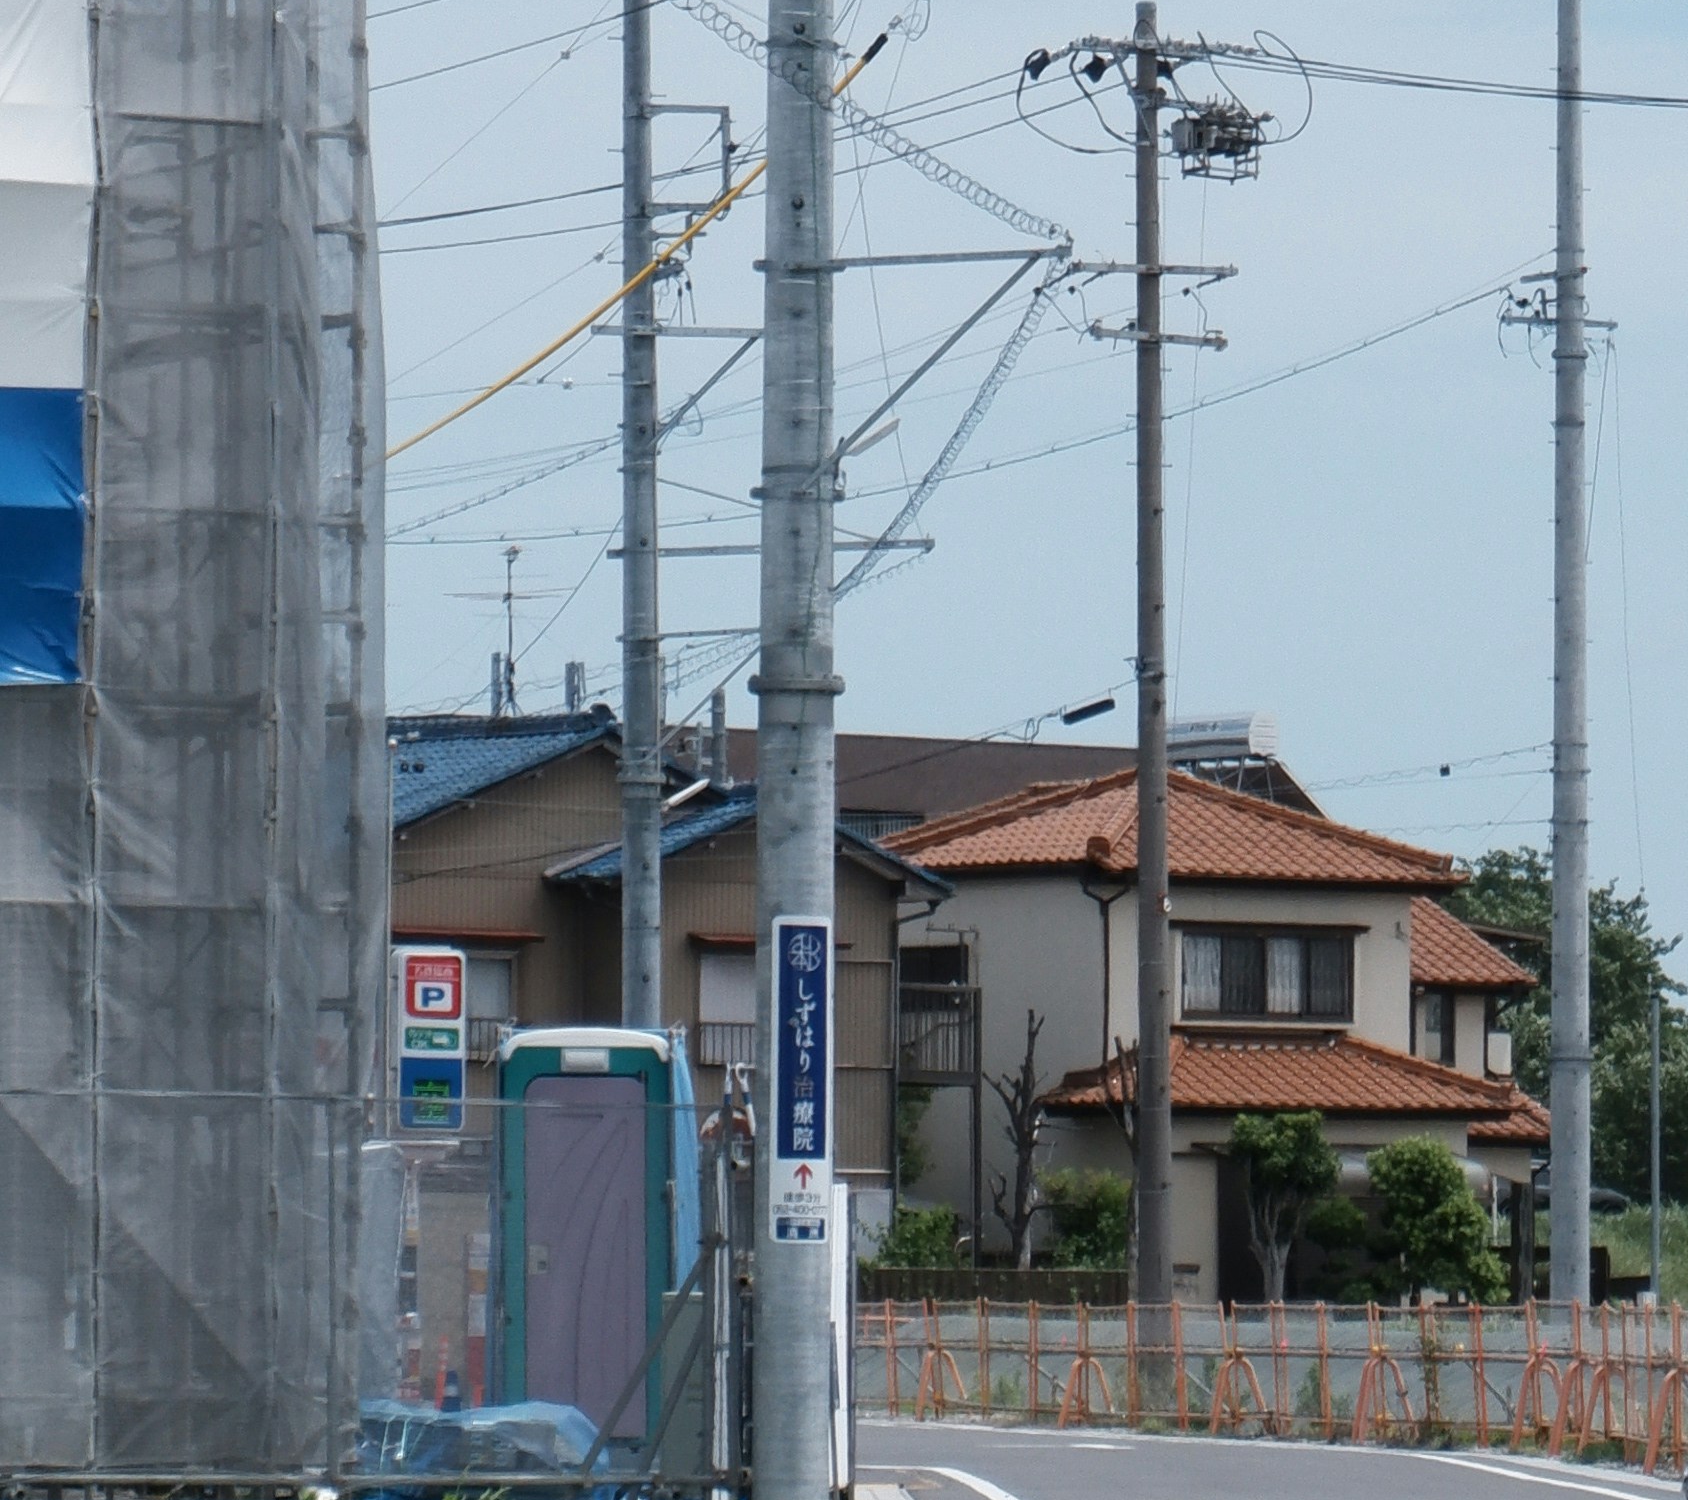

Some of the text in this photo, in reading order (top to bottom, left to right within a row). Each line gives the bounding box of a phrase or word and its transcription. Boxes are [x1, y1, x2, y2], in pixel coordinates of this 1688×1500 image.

[421, 986, 445, 1008] P
[793, 977, 816, 1151] しずはり治療院
